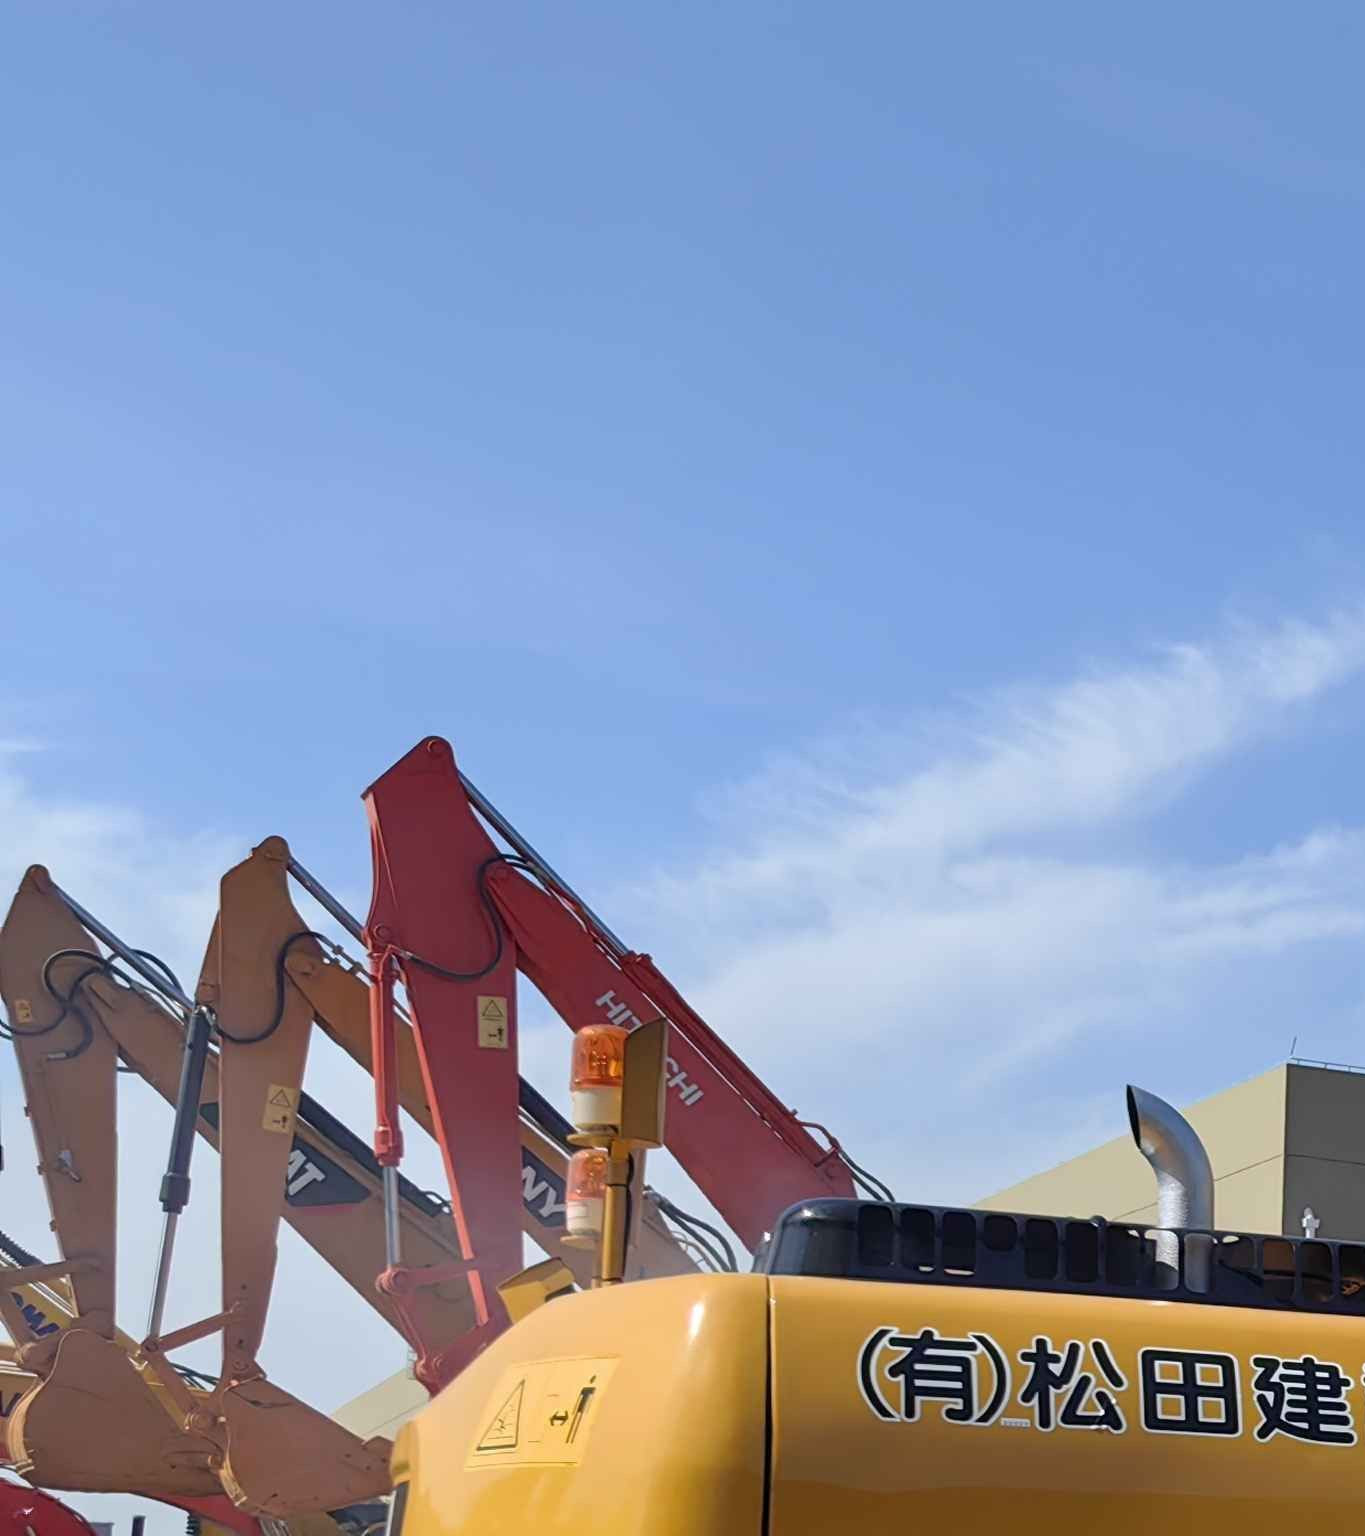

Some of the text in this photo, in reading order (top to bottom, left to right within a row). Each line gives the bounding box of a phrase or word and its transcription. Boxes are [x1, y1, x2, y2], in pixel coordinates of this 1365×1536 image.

[595, 990, 704, 1106] HICHI
[287, 1149, 326, 1196] AT
[522, 1165, 566, 1218] NY
